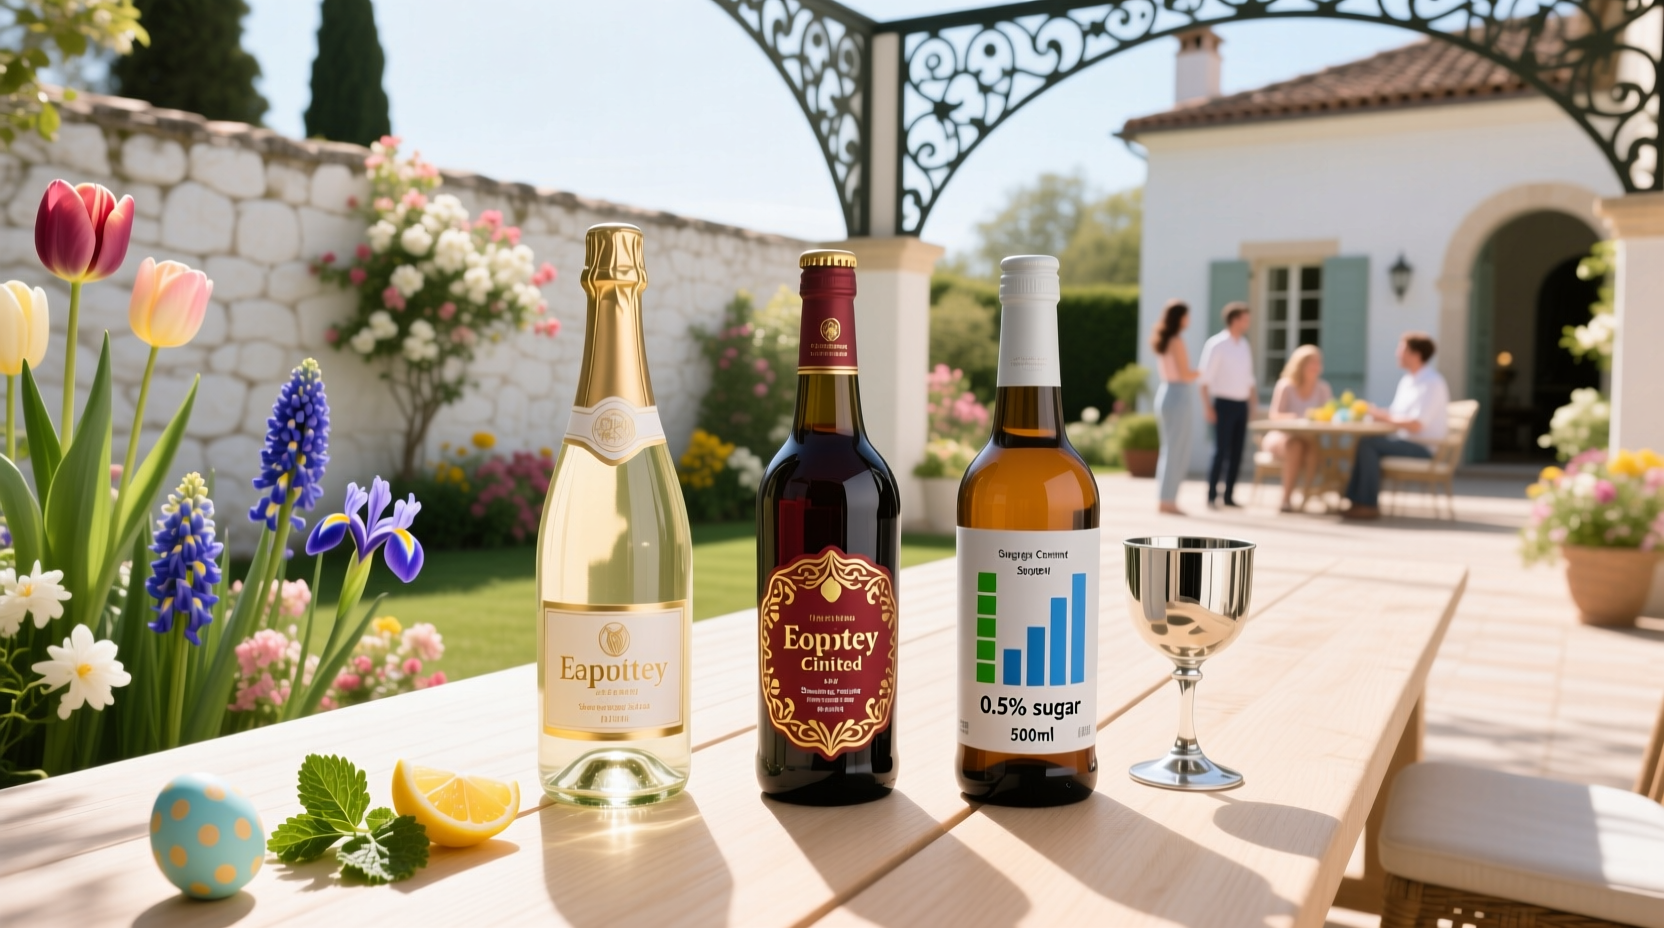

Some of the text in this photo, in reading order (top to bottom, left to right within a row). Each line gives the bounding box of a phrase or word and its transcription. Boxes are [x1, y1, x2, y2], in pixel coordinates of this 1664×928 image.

[980, 695, 1082, 720] 0.5% sugar
[1010, 726, 1054, 742] 500ml
